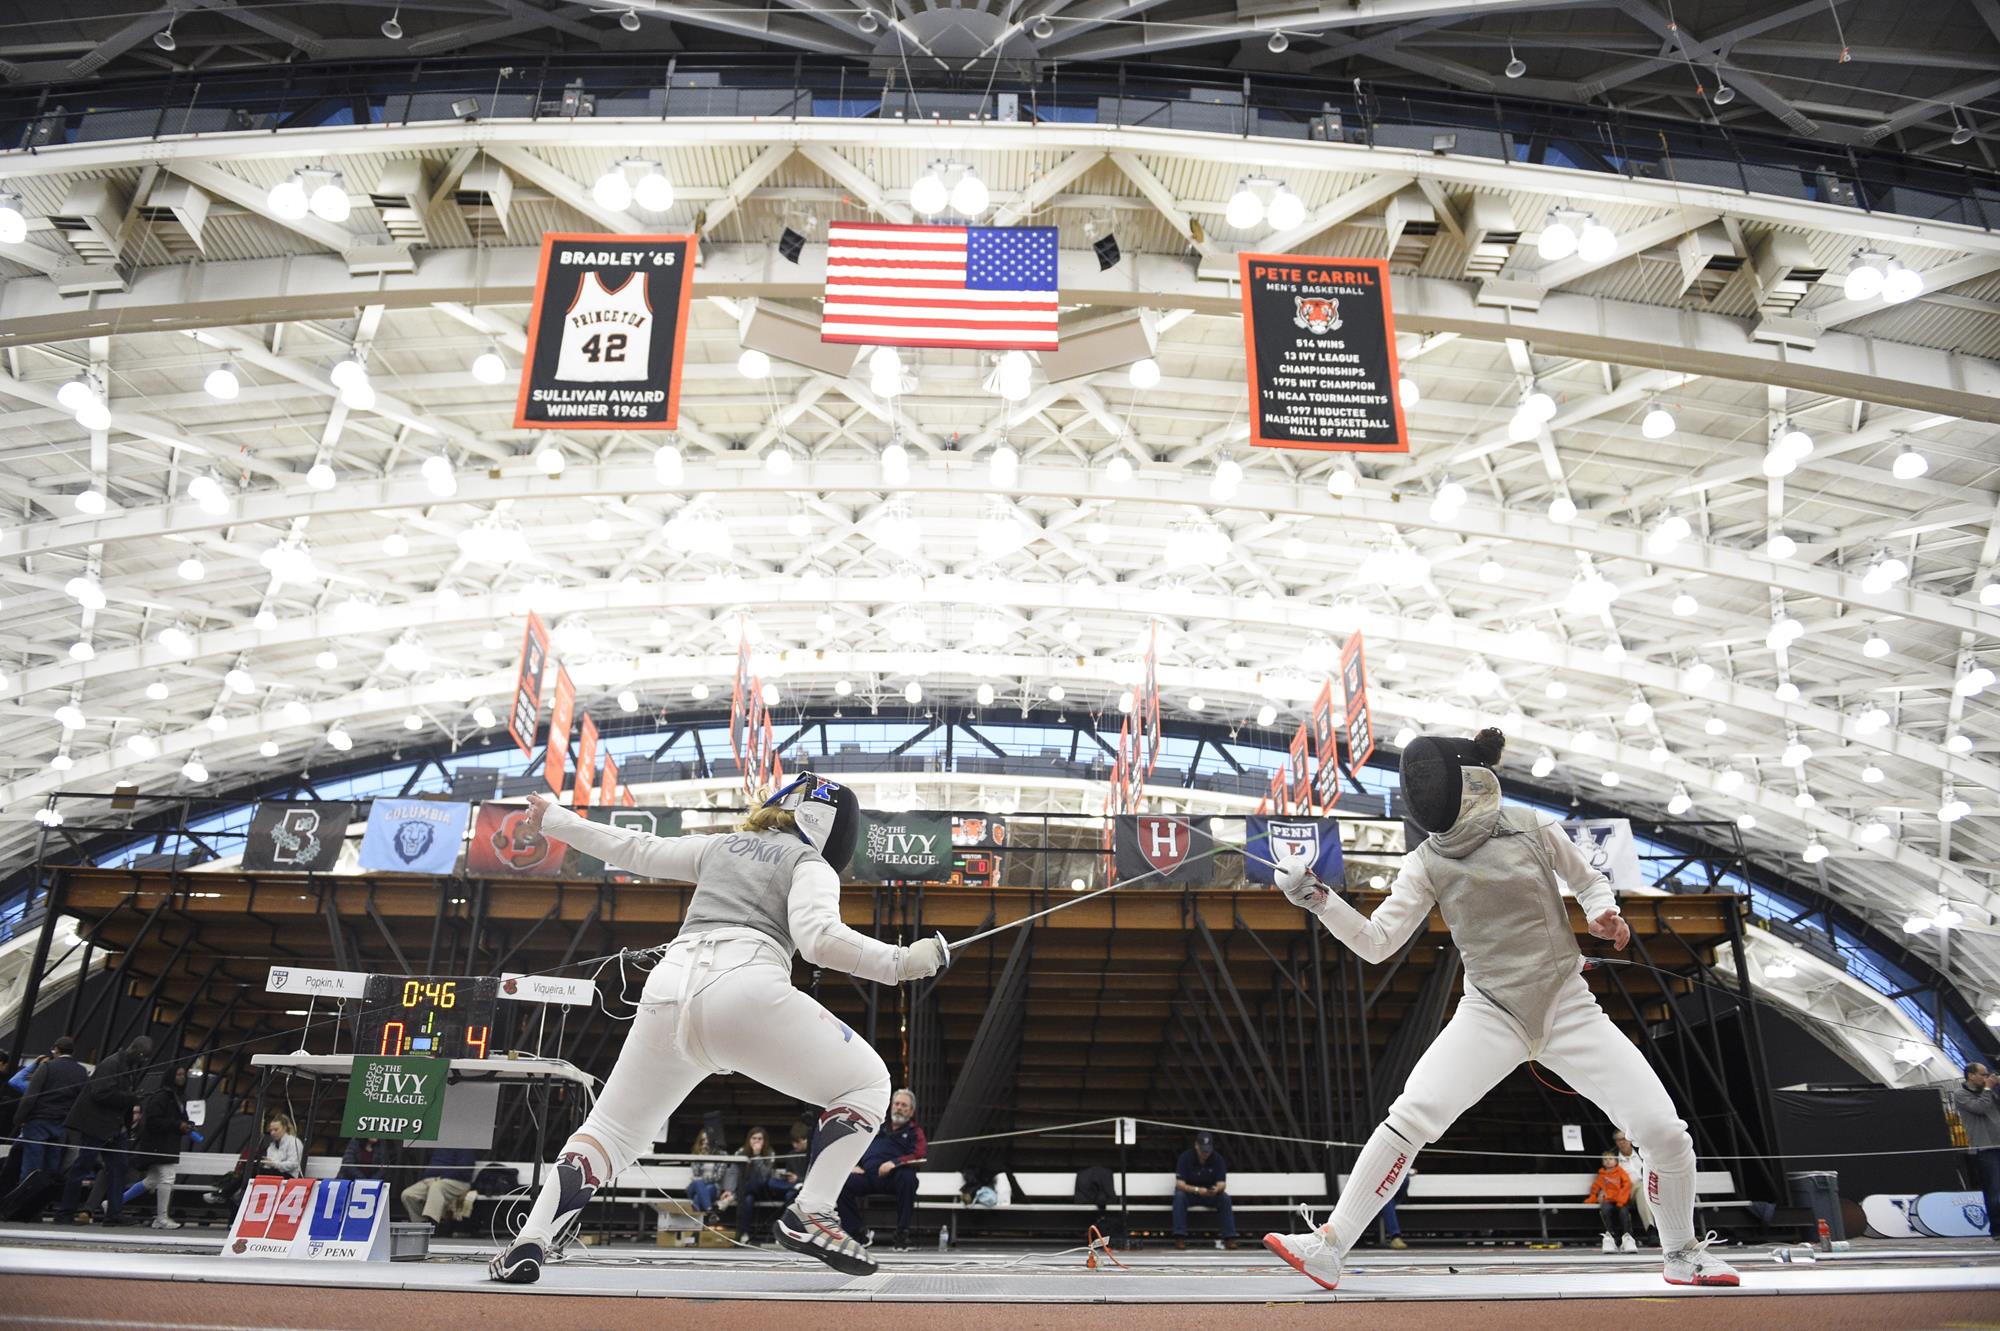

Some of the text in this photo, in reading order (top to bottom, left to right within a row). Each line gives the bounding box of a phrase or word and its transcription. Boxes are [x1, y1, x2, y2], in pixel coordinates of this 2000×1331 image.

[560, 251, 644, 265] BRADLEY
[1255, 266, 1374, 285] PETE CARRIL
[1266, 283, 1364, 296] MEN'S BASKETBALL
[572, 310, 646, 328] PRINCETON
[582, 334, 628, 362] 42
[1296, 339, 1344, 349] 514 WINS
[1284, 352, 1360, 363] 13 IVY LEAGUE
[1279, 364, 1366, 376] CHAMPIONSHIPS
[1272, 377, 1376, 390] 1975 NIT CHAMPION
[532, 390, 665, 402] SULLIVAN AWARD
[1263, 390, 1388, 404] 11 NCAA TOURNAMENTS
[546, 404, 648, 418] WINNER 1965
[1286, 406, 1366, 418] 1997 INDUCTEE
[1265, 414, 1390, 428] NAISMITH BASKETBALL
[1290, 426, 1366, 438] HALL OF FAME
[384, 804, 450, 824] COLUMBIA
[273, 808, 319, 864] B
[886, 826, 906, 834] THE
[1272, 826, 1312, 838] PENN
[885, 834, 936, 854] IVY
[1150, 822, 1178, 857] H
[720, 835, 792, 864] POPKIN
[305, 976, 344, 988] Popkin, N.
[402, 980, 456, 1008] 0:46
[533, 983, 576, 996] Viqueira, M.
[466, 1026, 488, 1059] 4
[384, 1064, 402, 1072] THE
[380, 1072, 428, 1094] IVY
[357, 1116, 422, 1133] STRIP 9
[250, 1244, 288, 1254] CORNELL
[324, 1248, 356, 1258] PENN
